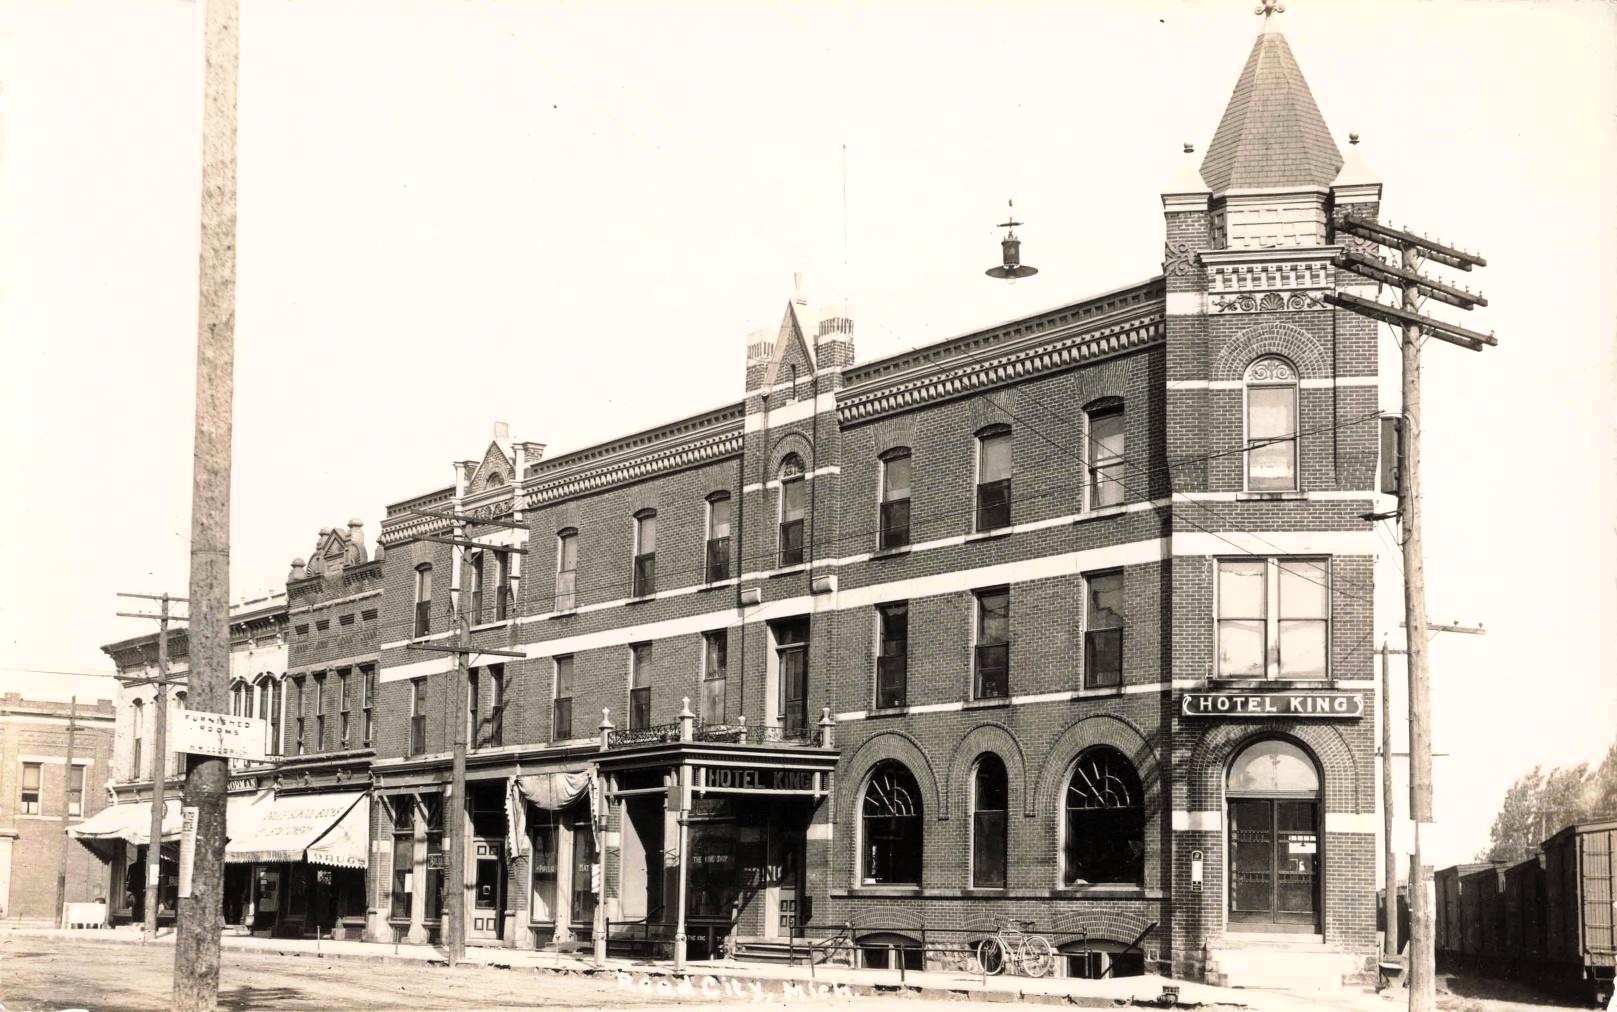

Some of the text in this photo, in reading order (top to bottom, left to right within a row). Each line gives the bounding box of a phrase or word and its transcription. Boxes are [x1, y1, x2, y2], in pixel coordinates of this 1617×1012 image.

[1200, 697, 1347, 712] HOTEL KING
[184, 714, 250, 729] FURNISHED
[200, 725, 239, 736] ROOMS
[708, 769, 812, 790] HOTEL KING
